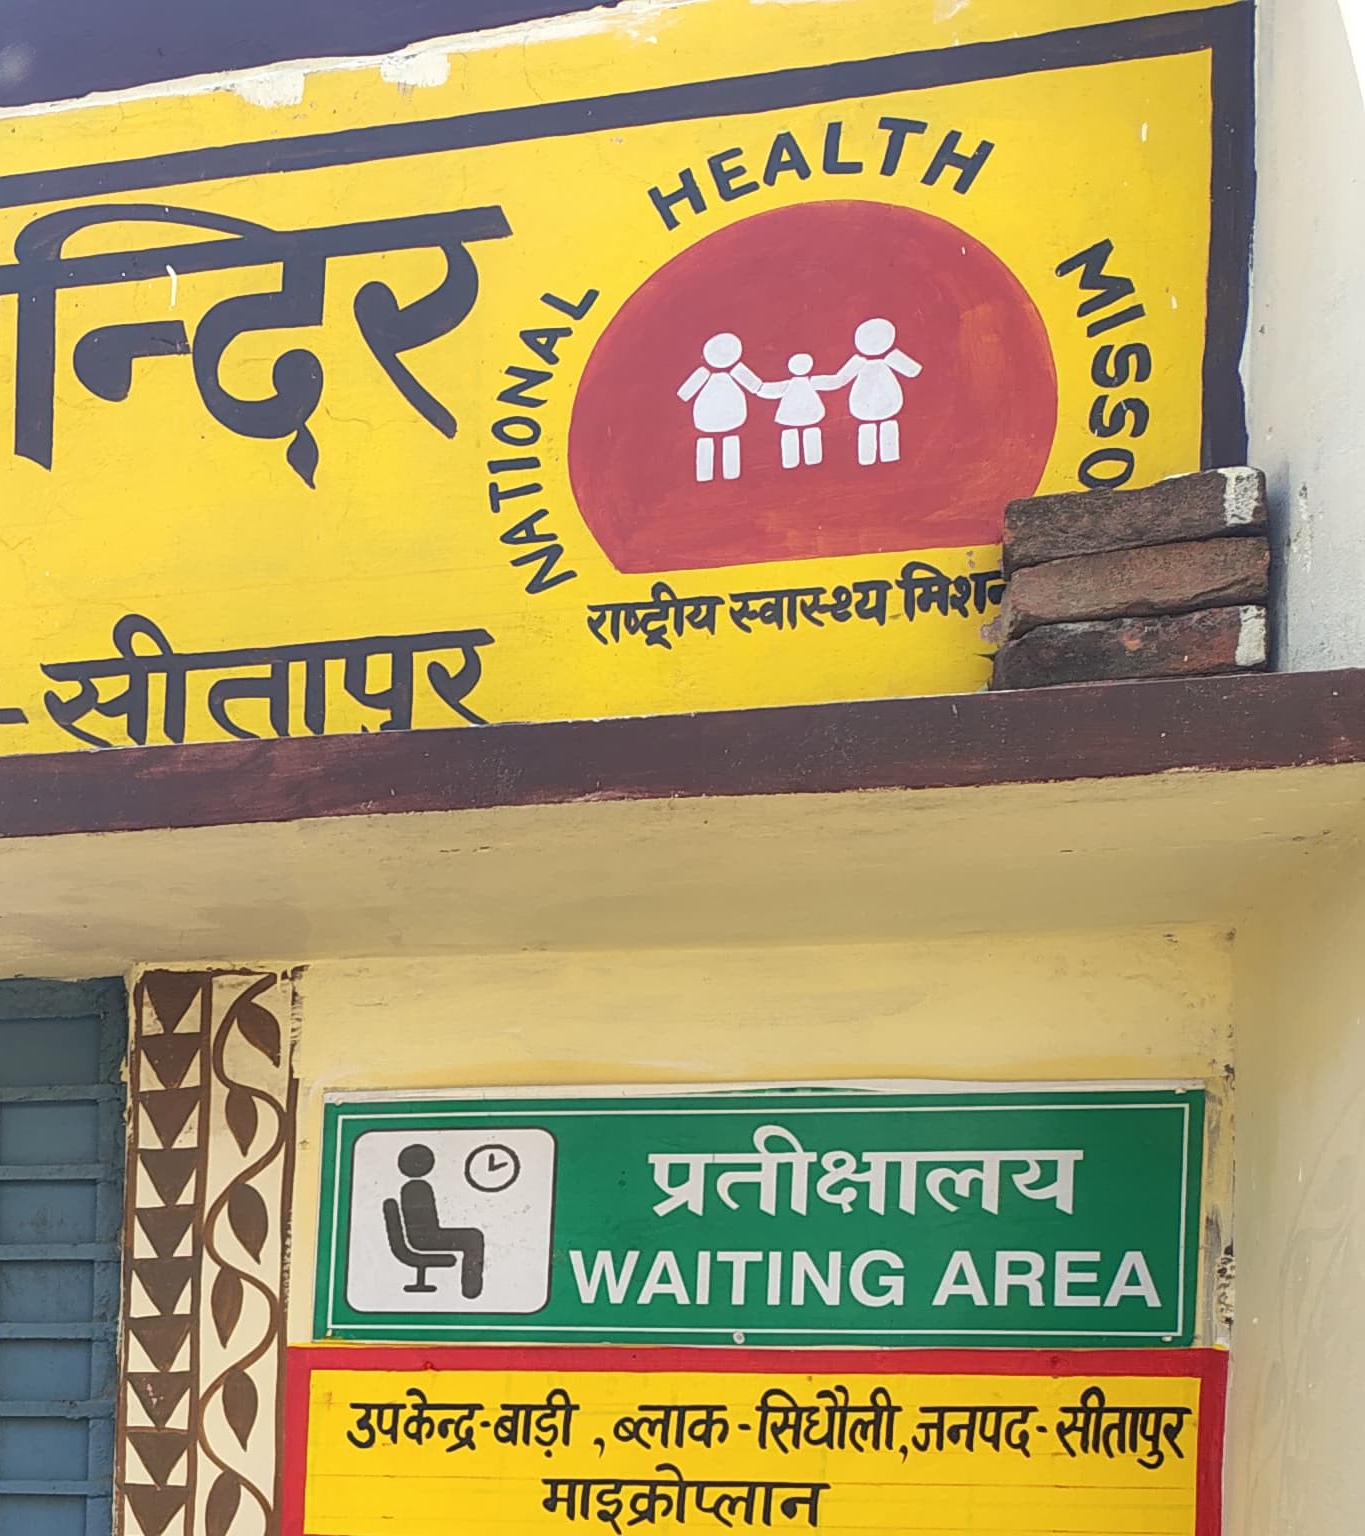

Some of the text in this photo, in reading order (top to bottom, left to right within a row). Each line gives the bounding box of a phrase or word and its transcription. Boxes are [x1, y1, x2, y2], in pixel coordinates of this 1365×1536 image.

[488, 116, 1152, 594] NATIONAL HEALTH MISSO
[588, 582, 725, 649] राष्ट्रीय
[729, 579, 892, 634] स्वास्थ्य
[647, 1124, 1083, 1218] प्रतीक्षालय
[568, 1249, 1163, 1309] WAITING AREA
[543, 1464, 830, 1534] माइक्रोप्लान
